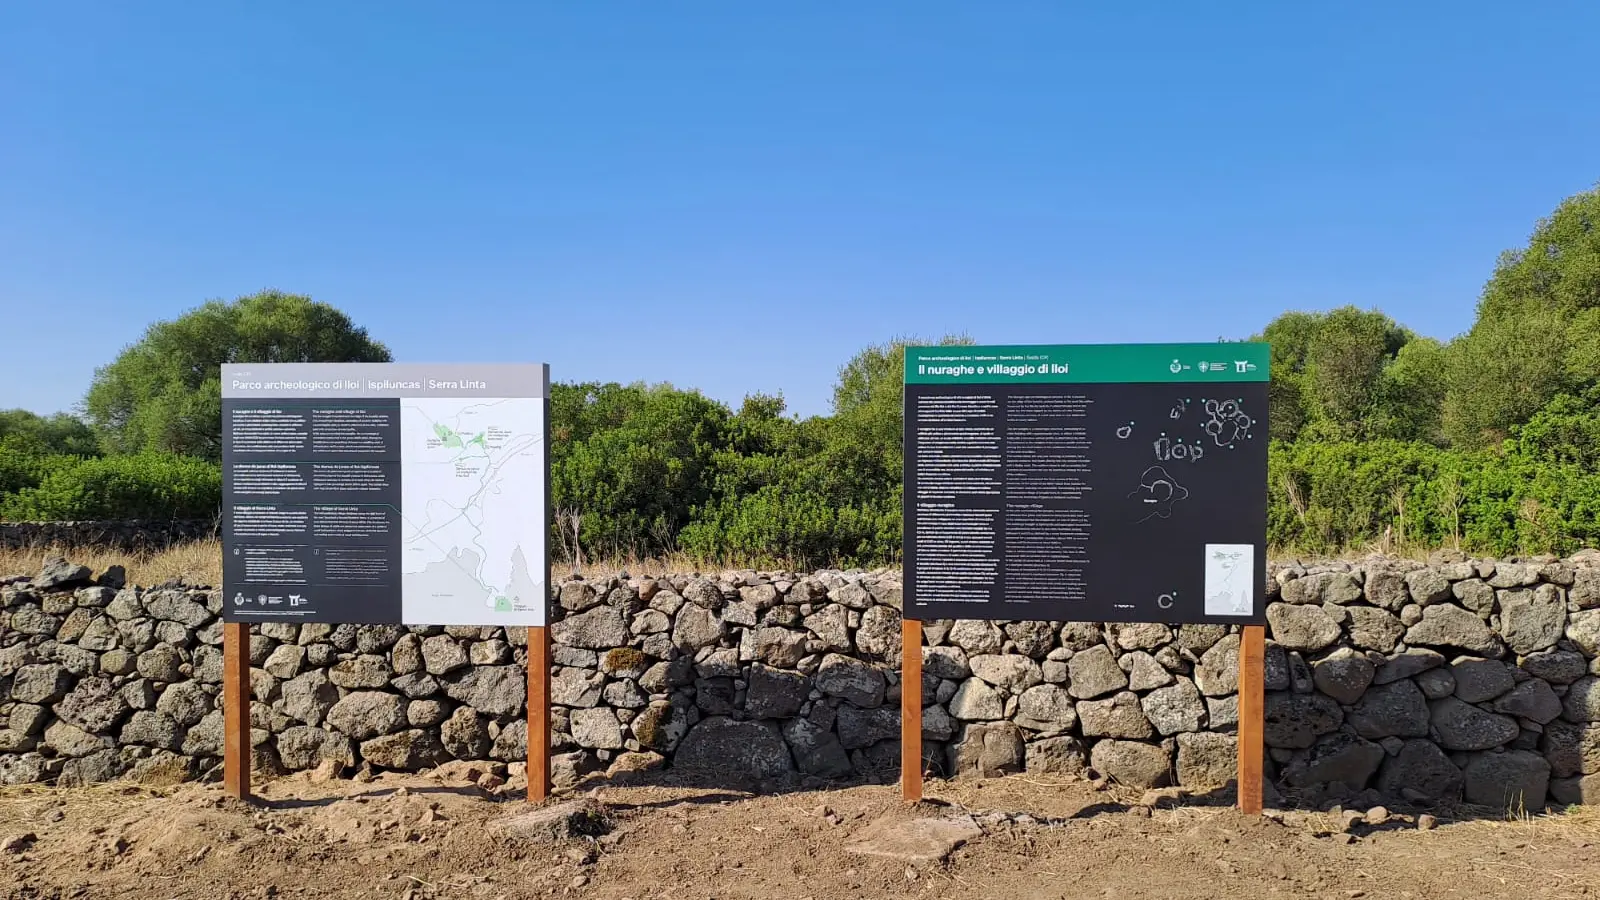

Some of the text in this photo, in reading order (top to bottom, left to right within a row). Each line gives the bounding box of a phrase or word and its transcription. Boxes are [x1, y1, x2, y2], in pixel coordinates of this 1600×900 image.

[918, 364, 925, 375] Il
[928, 364, 975, 376] nuraghe
[977, 366, 985, 375] e
[987, 364, 1035, 376] villaggio
[1037, 364, 1048, 374] di
[232, 380, 261, 389] Parco
[264, 380, 330, 391] archeologico
[332, 379, 342, 389] di
[368, 380, 420, 391] Ispiluncas
[429, 379, 486, 389] Serra Linta
